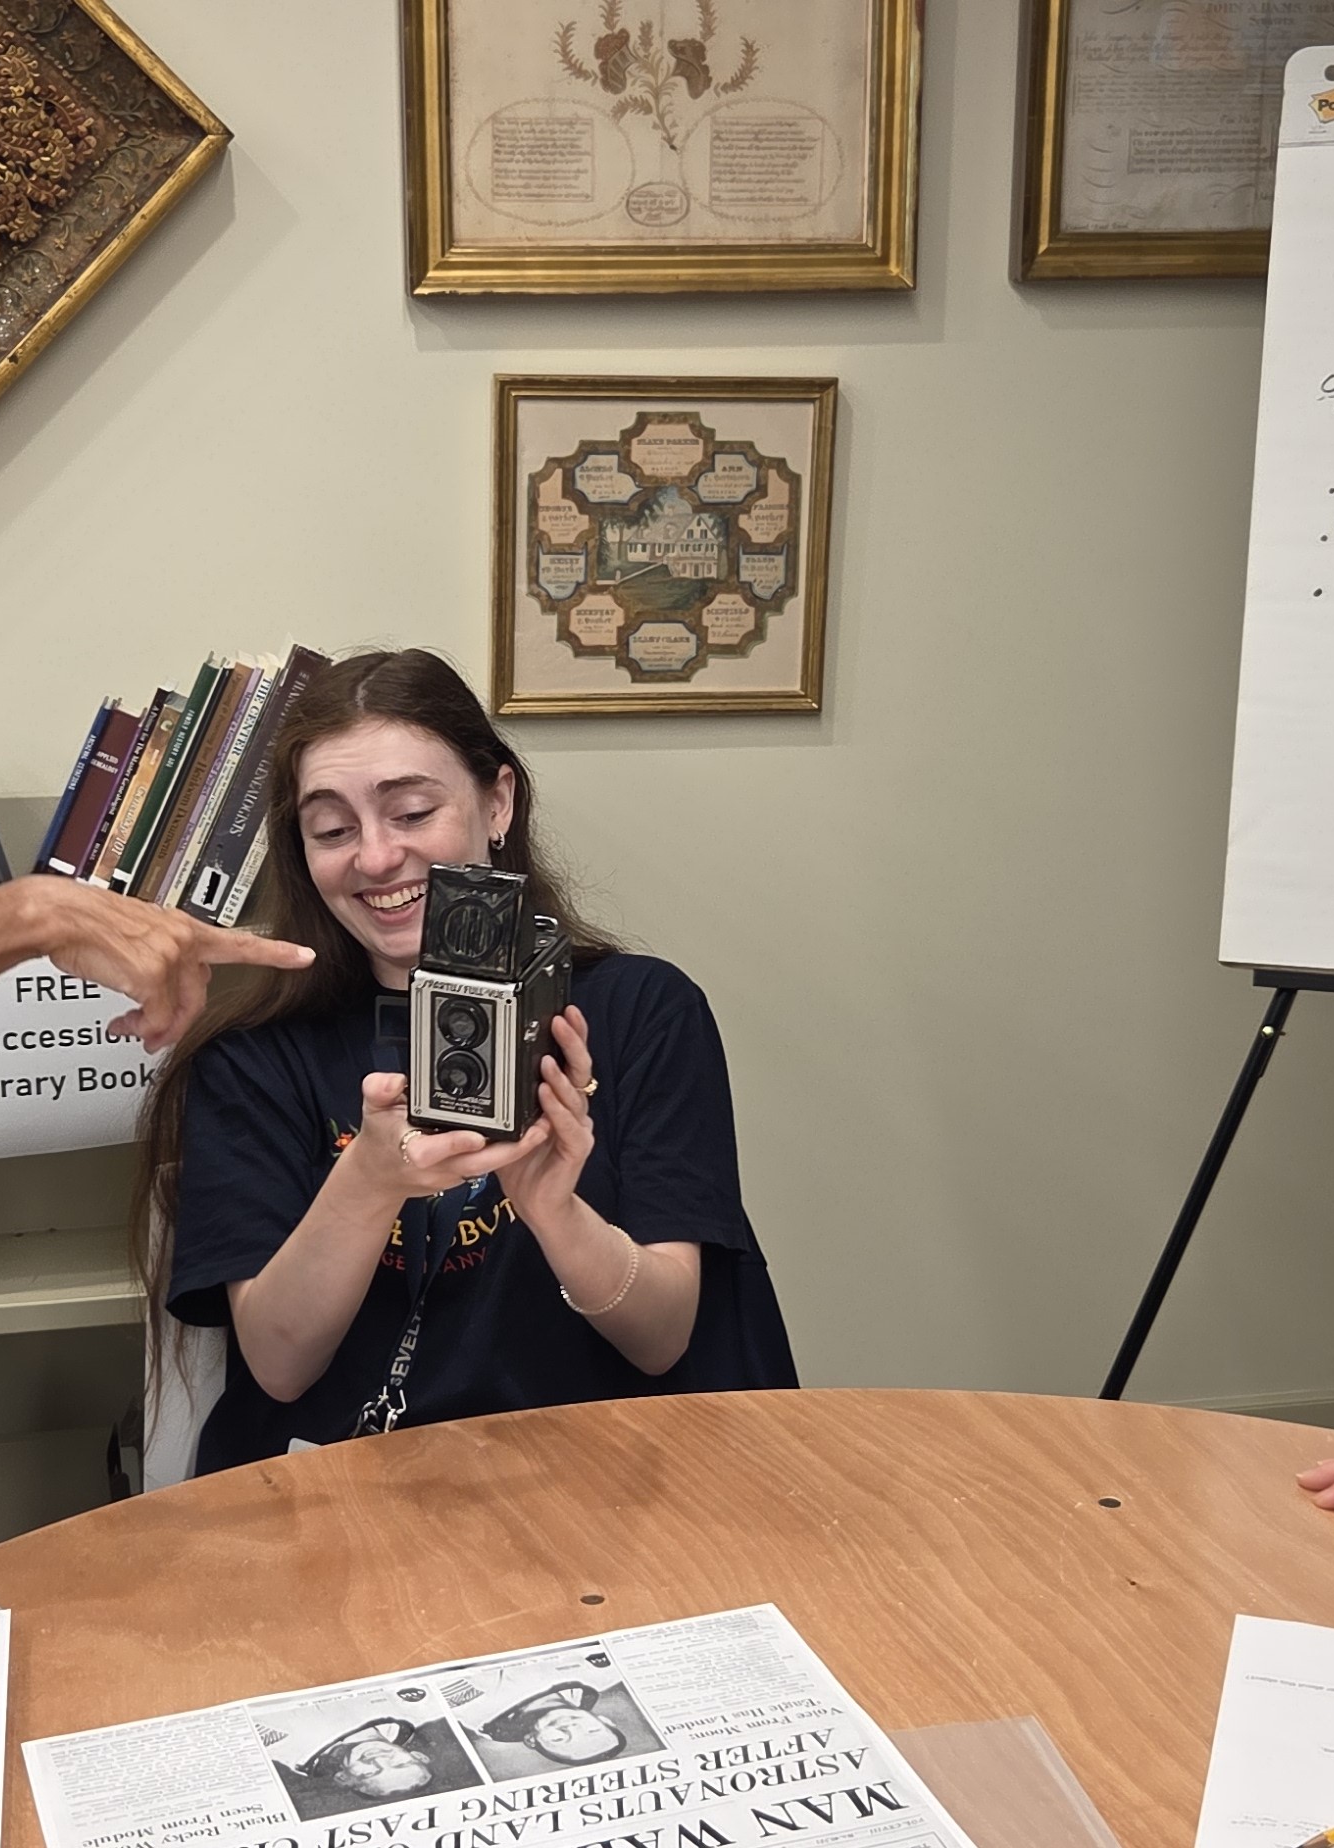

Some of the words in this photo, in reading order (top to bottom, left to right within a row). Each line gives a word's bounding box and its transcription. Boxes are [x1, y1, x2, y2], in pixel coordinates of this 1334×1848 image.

[253, 675, 273, 704] THE
[230, 704, 260, 757] CENTER
[109, 835, 126, 856] 101
[16, 975, 101, 1003] FREE
[381, 1248, 489, 1274] GEANY
[730, 1705, 764, 1721] Has
[743, 1713, 791, 1732] From
[792, 1703, 843, 1722] Voice
[692, 1725, 837, 1773] AFTER
[455, 1756, 682, 1823] STEERING
[576, 1745, 873, 1826] ASTRONAUTS
[218, 1802, 264, 1820] Seen
[225, 1809, 288, 1833] Bleak,
[748, 1777, 903, 1839] MAN
[159, 1824, 220, 1846] Rocky
[160, 1812, 212, 1832] From
[313, 1805, 443, 1848] PAST
[431, 1807, 567, 1848] LAND
[80, 1825, 154, 1848] Module
